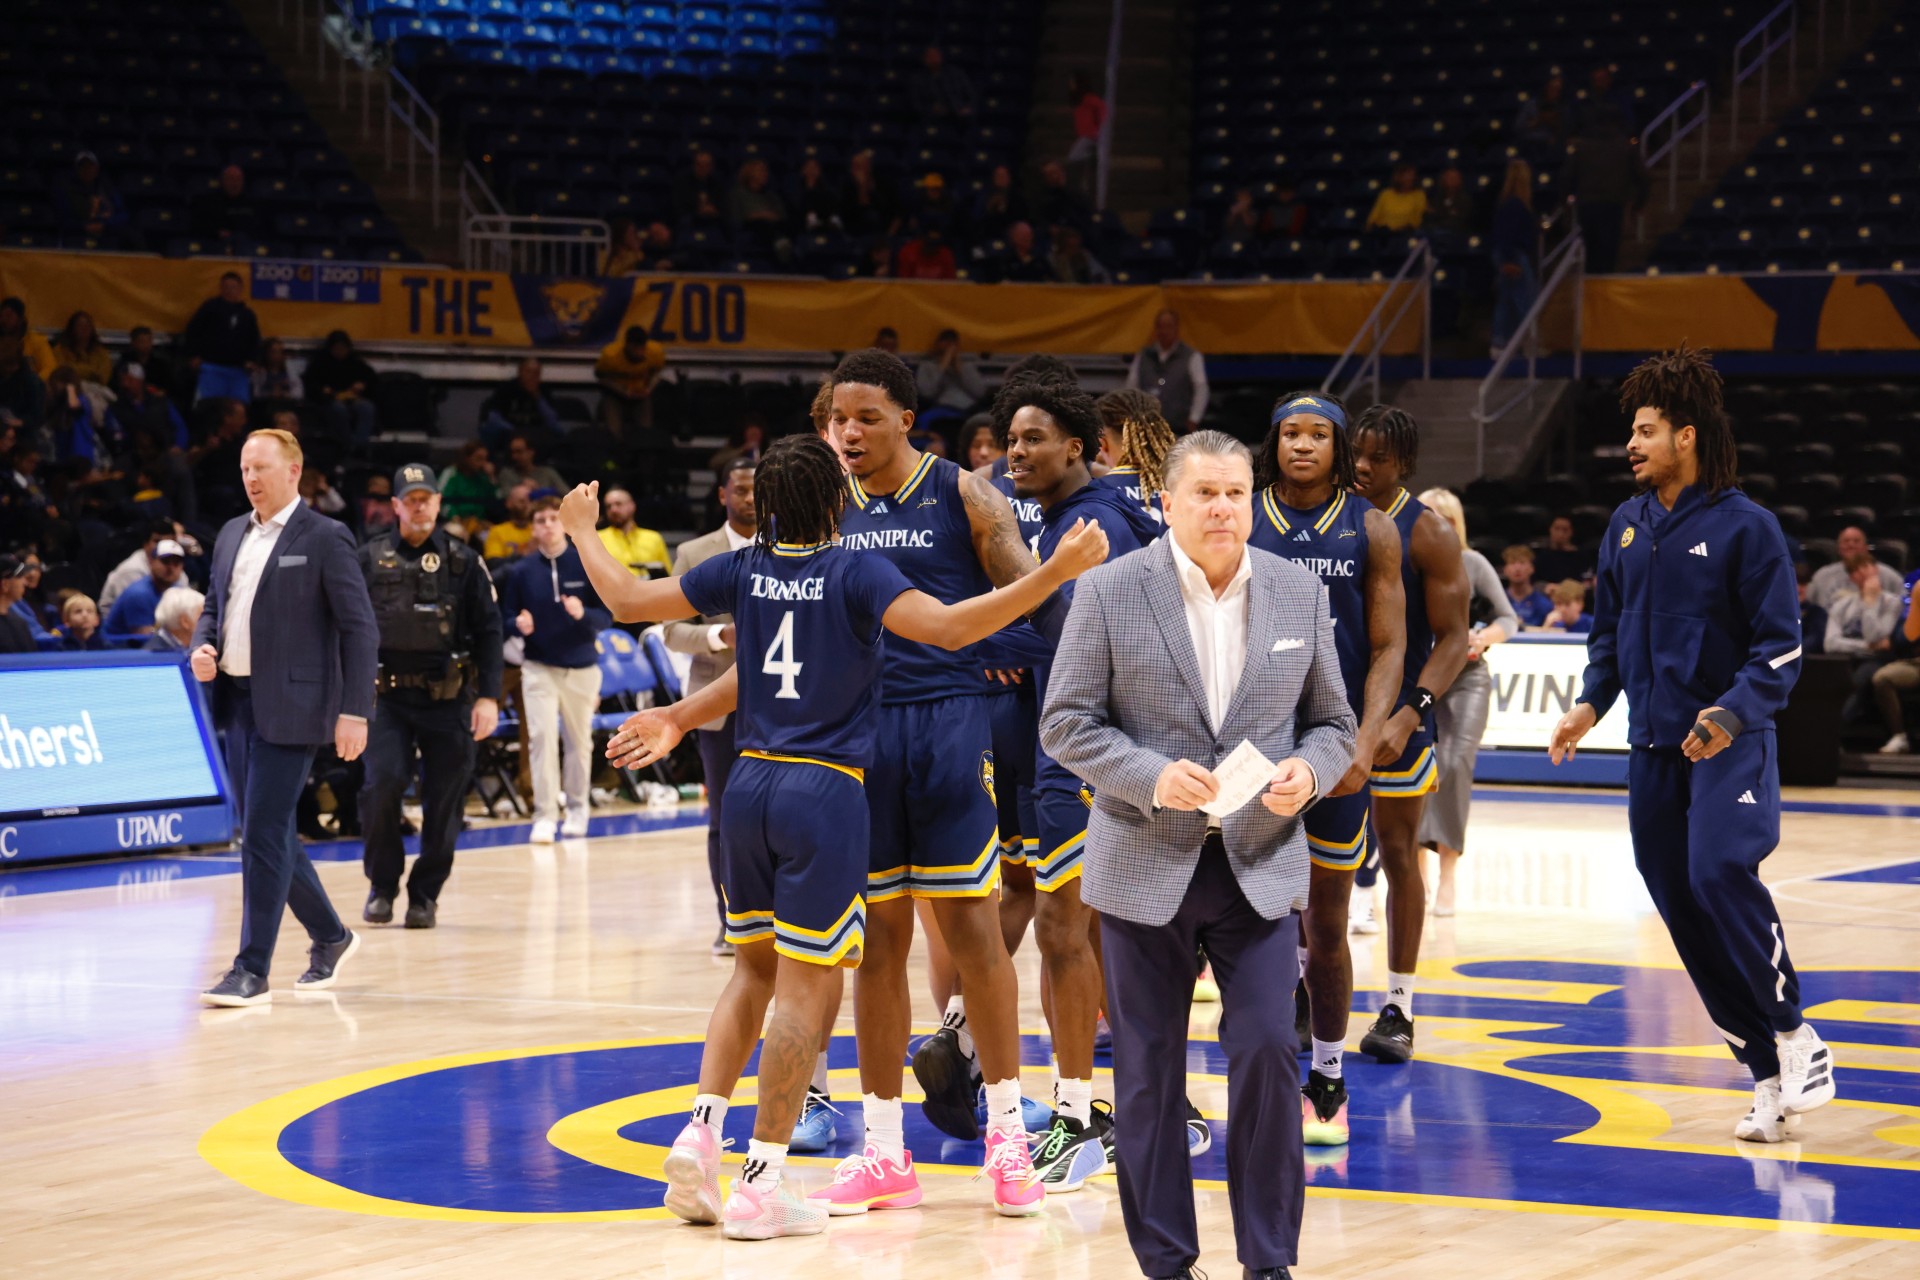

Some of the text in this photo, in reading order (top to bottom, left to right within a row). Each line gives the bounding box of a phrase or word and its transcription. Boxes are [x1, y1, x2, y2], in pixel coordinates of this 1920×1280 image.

[255, 263, 294, 281] ZOO
[321, 266, 359, 284] ZOO
[402, 277, 745, 342] THE ZOO
[840, 529, 934, 550] UINNIPIAC
[750, 573, 825, 601] TURNAGE
[762, 610, 803, 699] 4
[116, 813, 183, 848] UPMC
